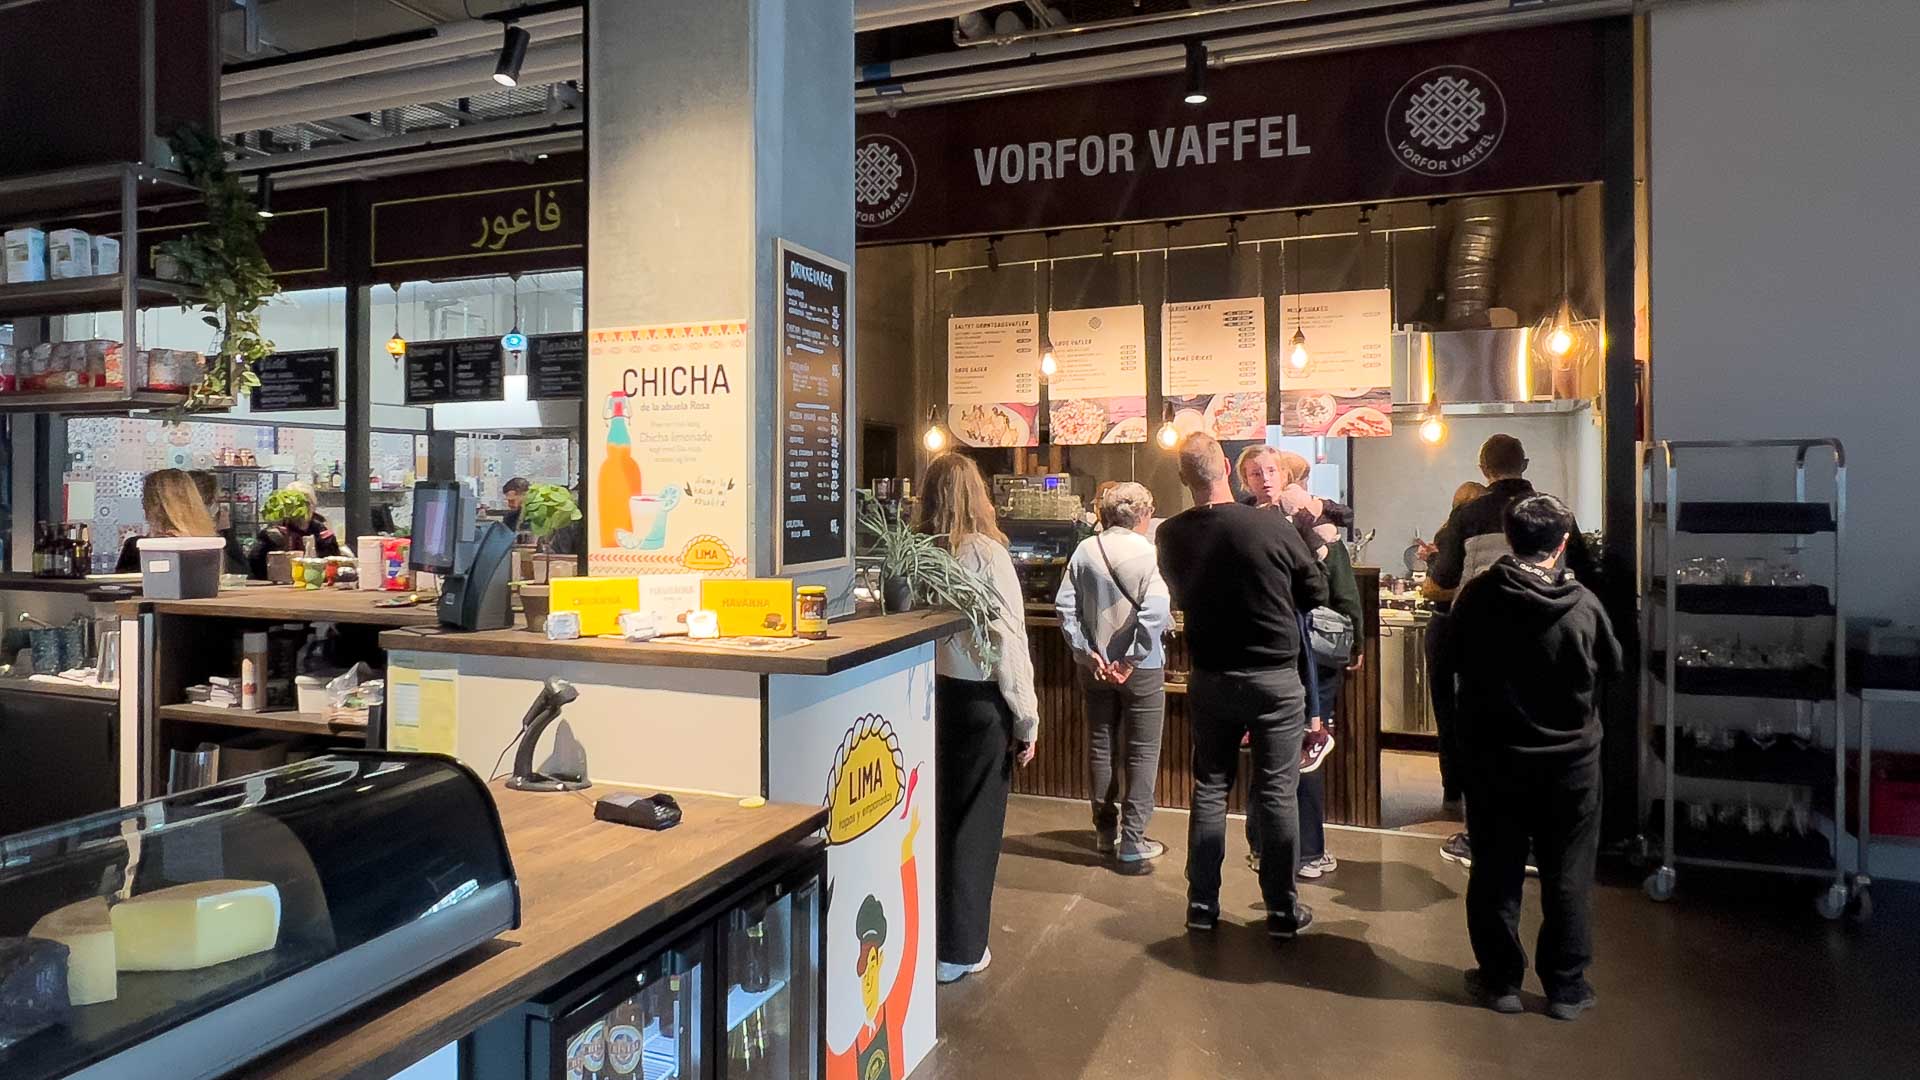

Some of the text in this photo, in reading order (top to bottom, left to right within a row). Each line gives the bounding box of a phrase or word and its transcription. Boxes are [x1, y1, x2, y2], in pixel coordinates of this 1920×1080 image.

[974, 114, 1311, 186] VORFOR VAFFEL
[1398, 134, 1495, 170] VORFOR VAFFEL
[470, 189, 561, 250] فاعور
[878, 192, 909, 220] VAFFEL
[622, 364, 731, 398] CHICHA
[640, 402, 651, 412] de
[690, 400, 711, 410] Rosa
[695, 549, 718, 560] LIMA
[721, 599, 770, 609] HAVANNA
[849, 757, 883, 806] LIMA
